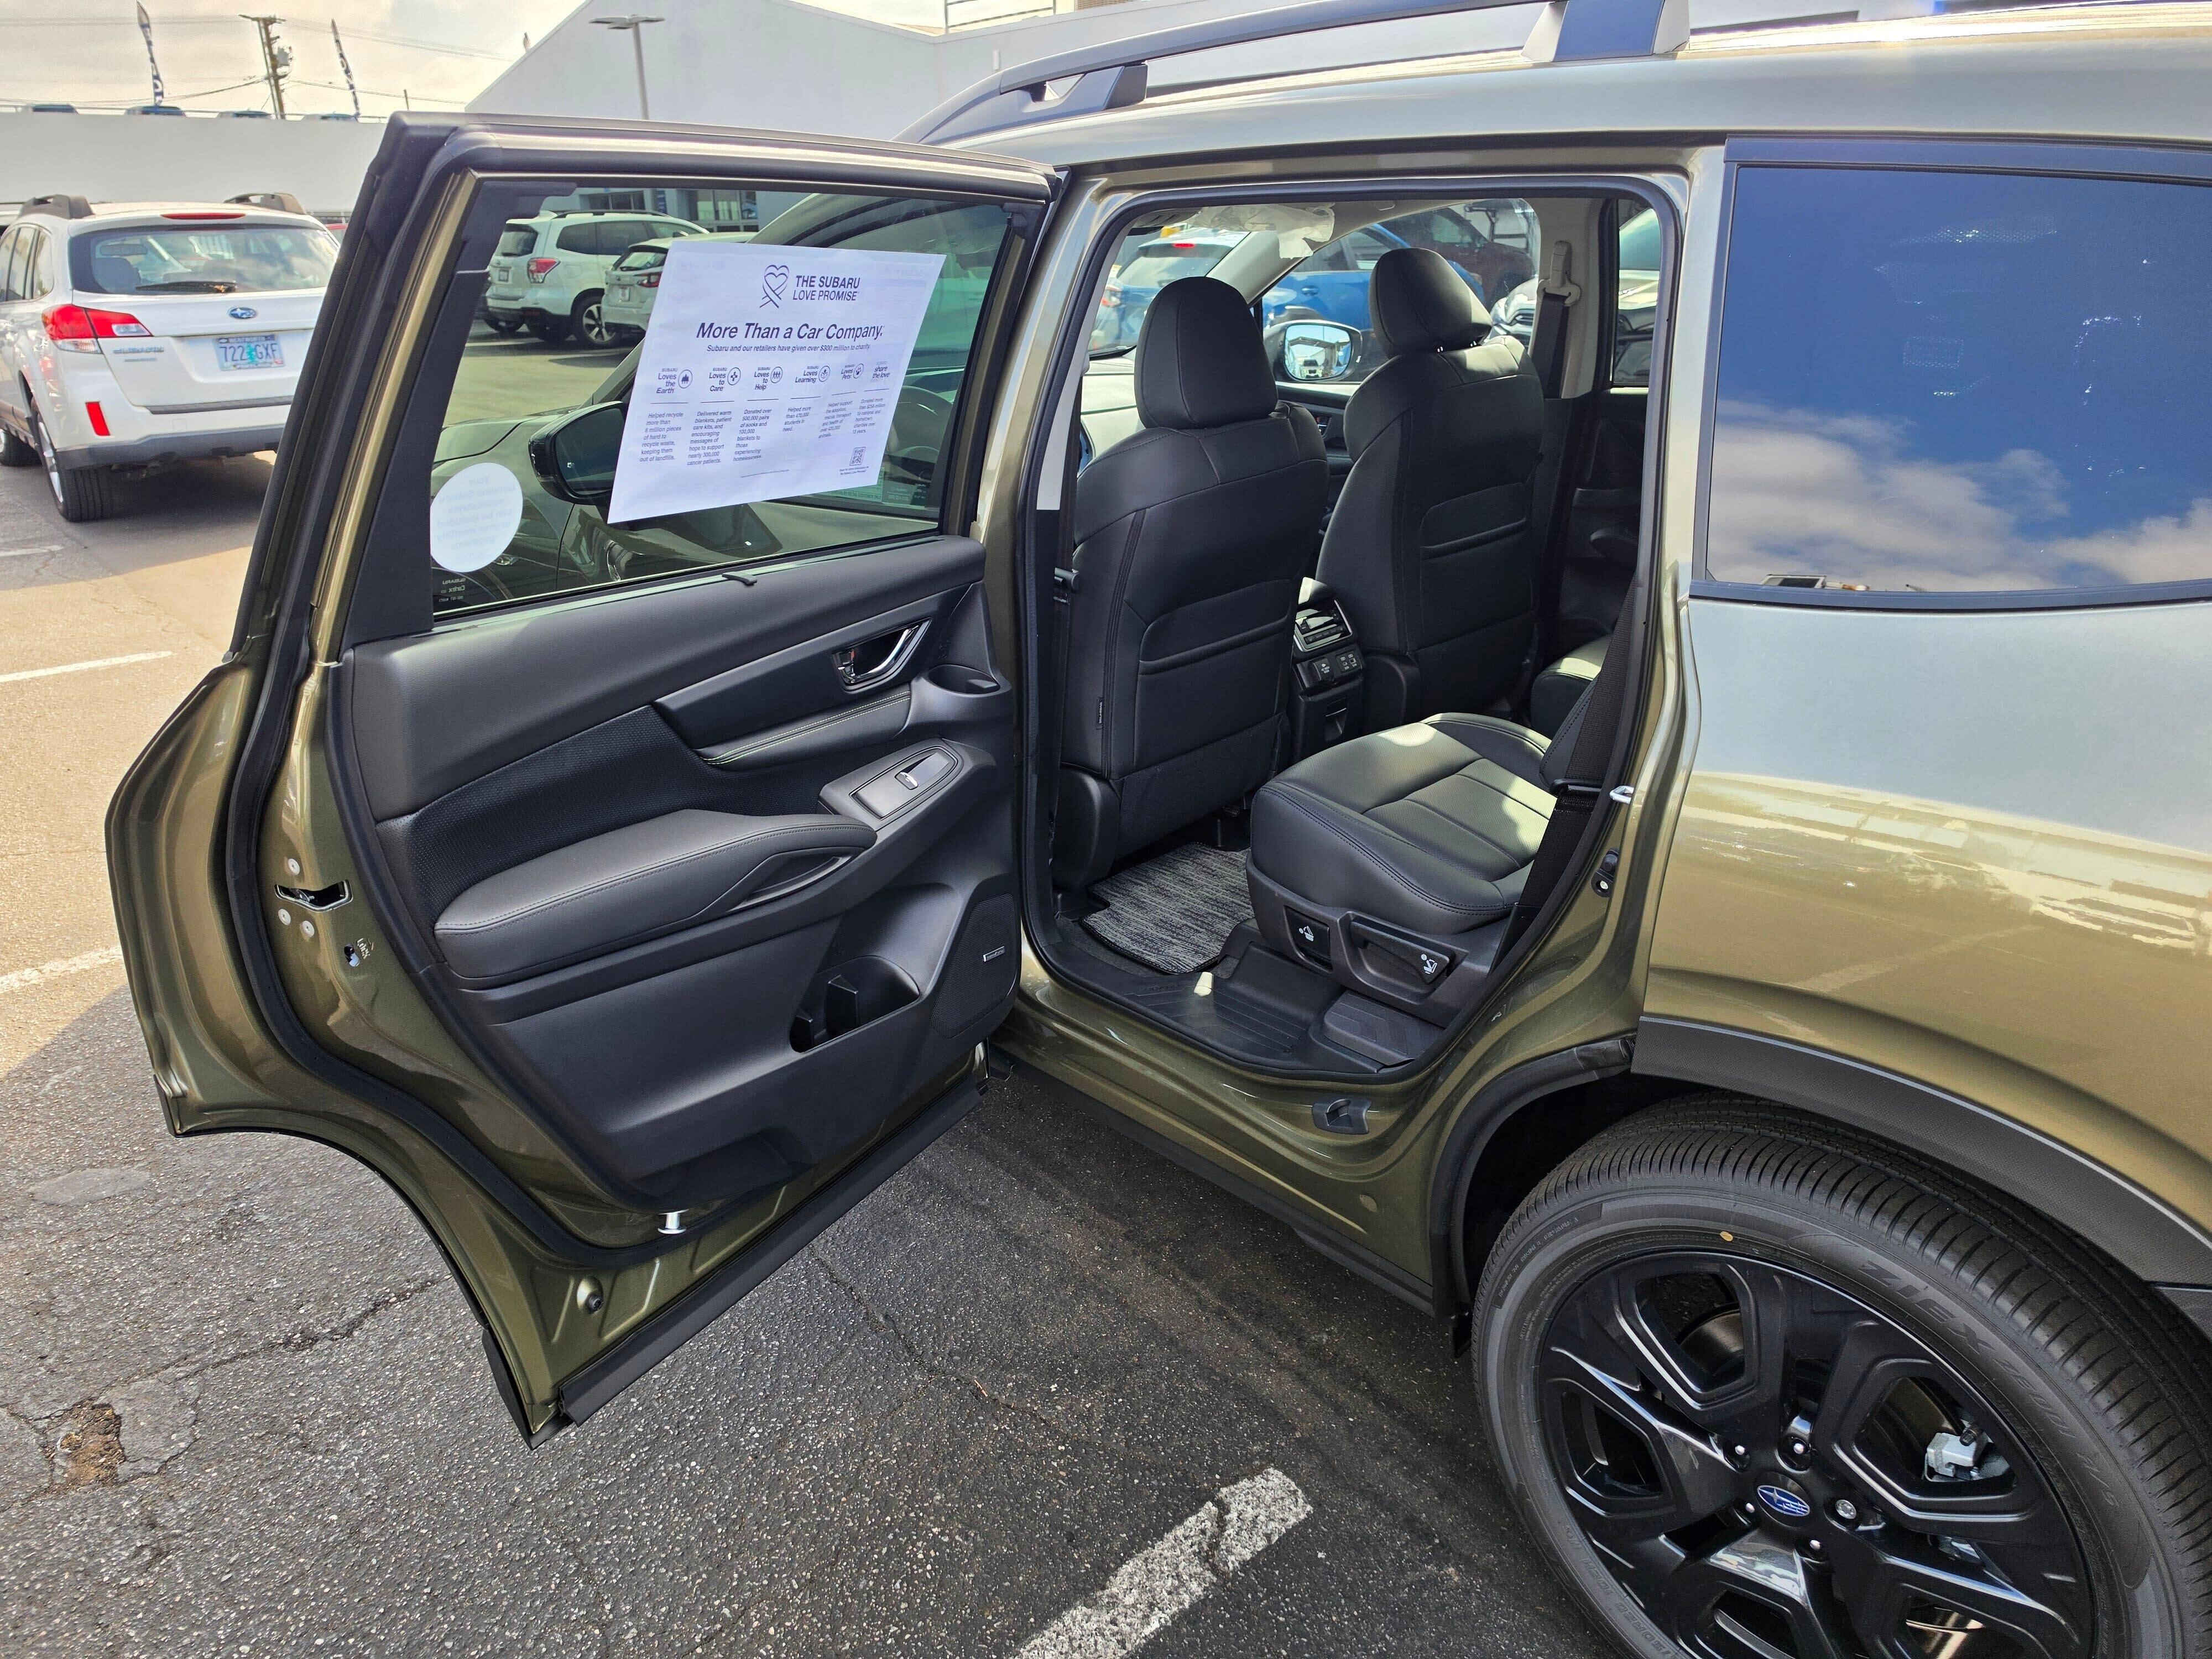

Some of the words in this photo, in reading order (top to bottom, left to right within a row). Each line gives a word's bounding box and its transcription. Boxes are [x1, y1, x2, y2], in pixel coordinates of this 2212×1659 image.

[796, 275, 815, 288] THE
[818, 276, 860, 289] SUBARU
[793, 290, 816, 300] LOVE
[696, 322, 738, 338] More
[744, 322, 780, 338] Than
[784, 327, 793, 338] a
[797, 324, 823, 339] Car
[219, 346, 247, 362] 722
[254, 343, 278, 359] GXF
[1859, 1261, 1995, 1357] ZIEX
